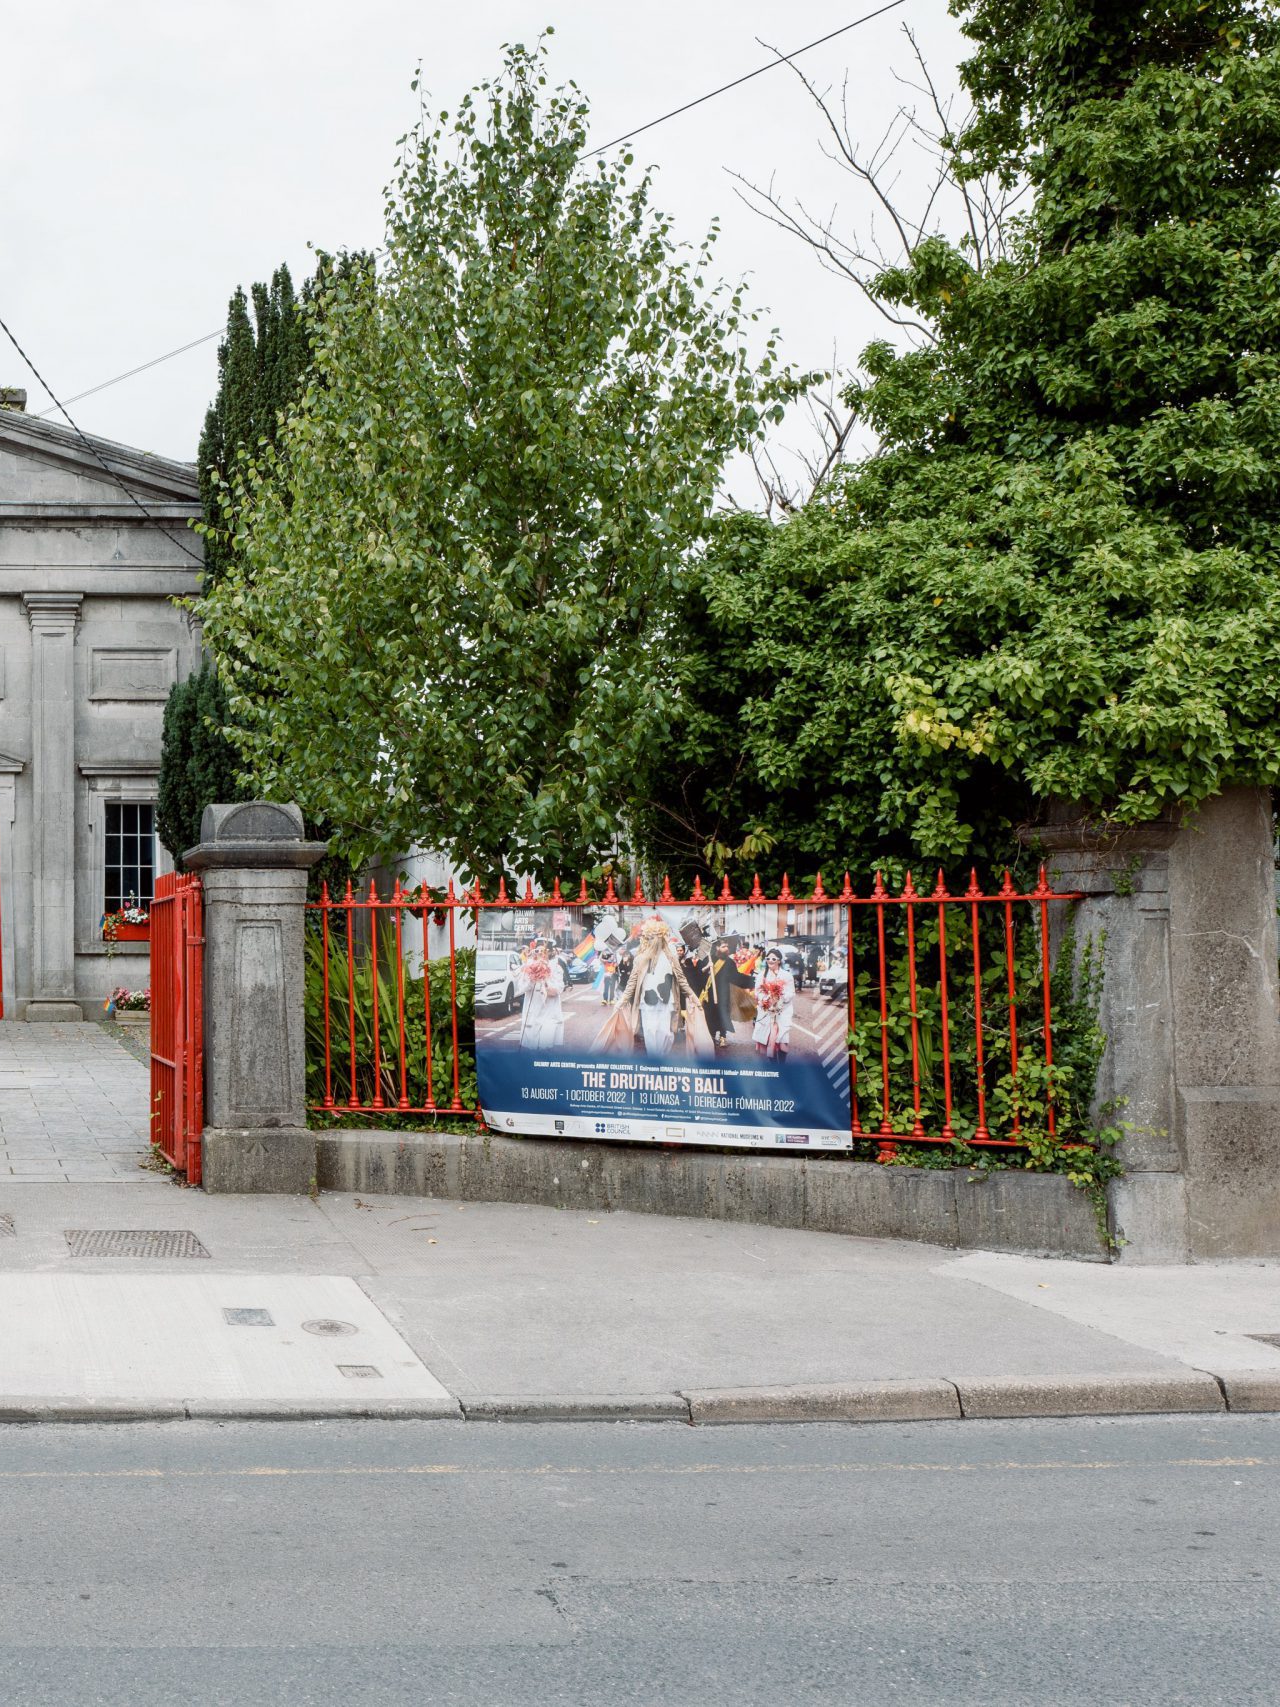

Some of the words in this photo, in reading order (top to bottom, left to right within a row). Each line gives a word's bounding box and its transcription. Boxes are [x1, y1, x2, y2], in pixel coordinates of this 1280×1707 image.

[582, 1072, 606, 1088] THE
[610, 1072, 690, 1092] DRUTHAIB'S
[694, 1078, 727, 1094] BALL
[522, 1088, 528, 1099] 13
[530, 1088, 558, 1100] AUGUST
[571, 1090, 604, 1102] OCTOBER
[607, 1092, 626, 1104] 2022
[640, 1092, 648, 1104] 13
[650, 1092, 680, 1106] LÚNASA
[694, 1096, 732, 1109] DEIREADH
[736, 1096, 772, 1110] FÓMHAIR
[774, 1100, 794, 1112] 2022
